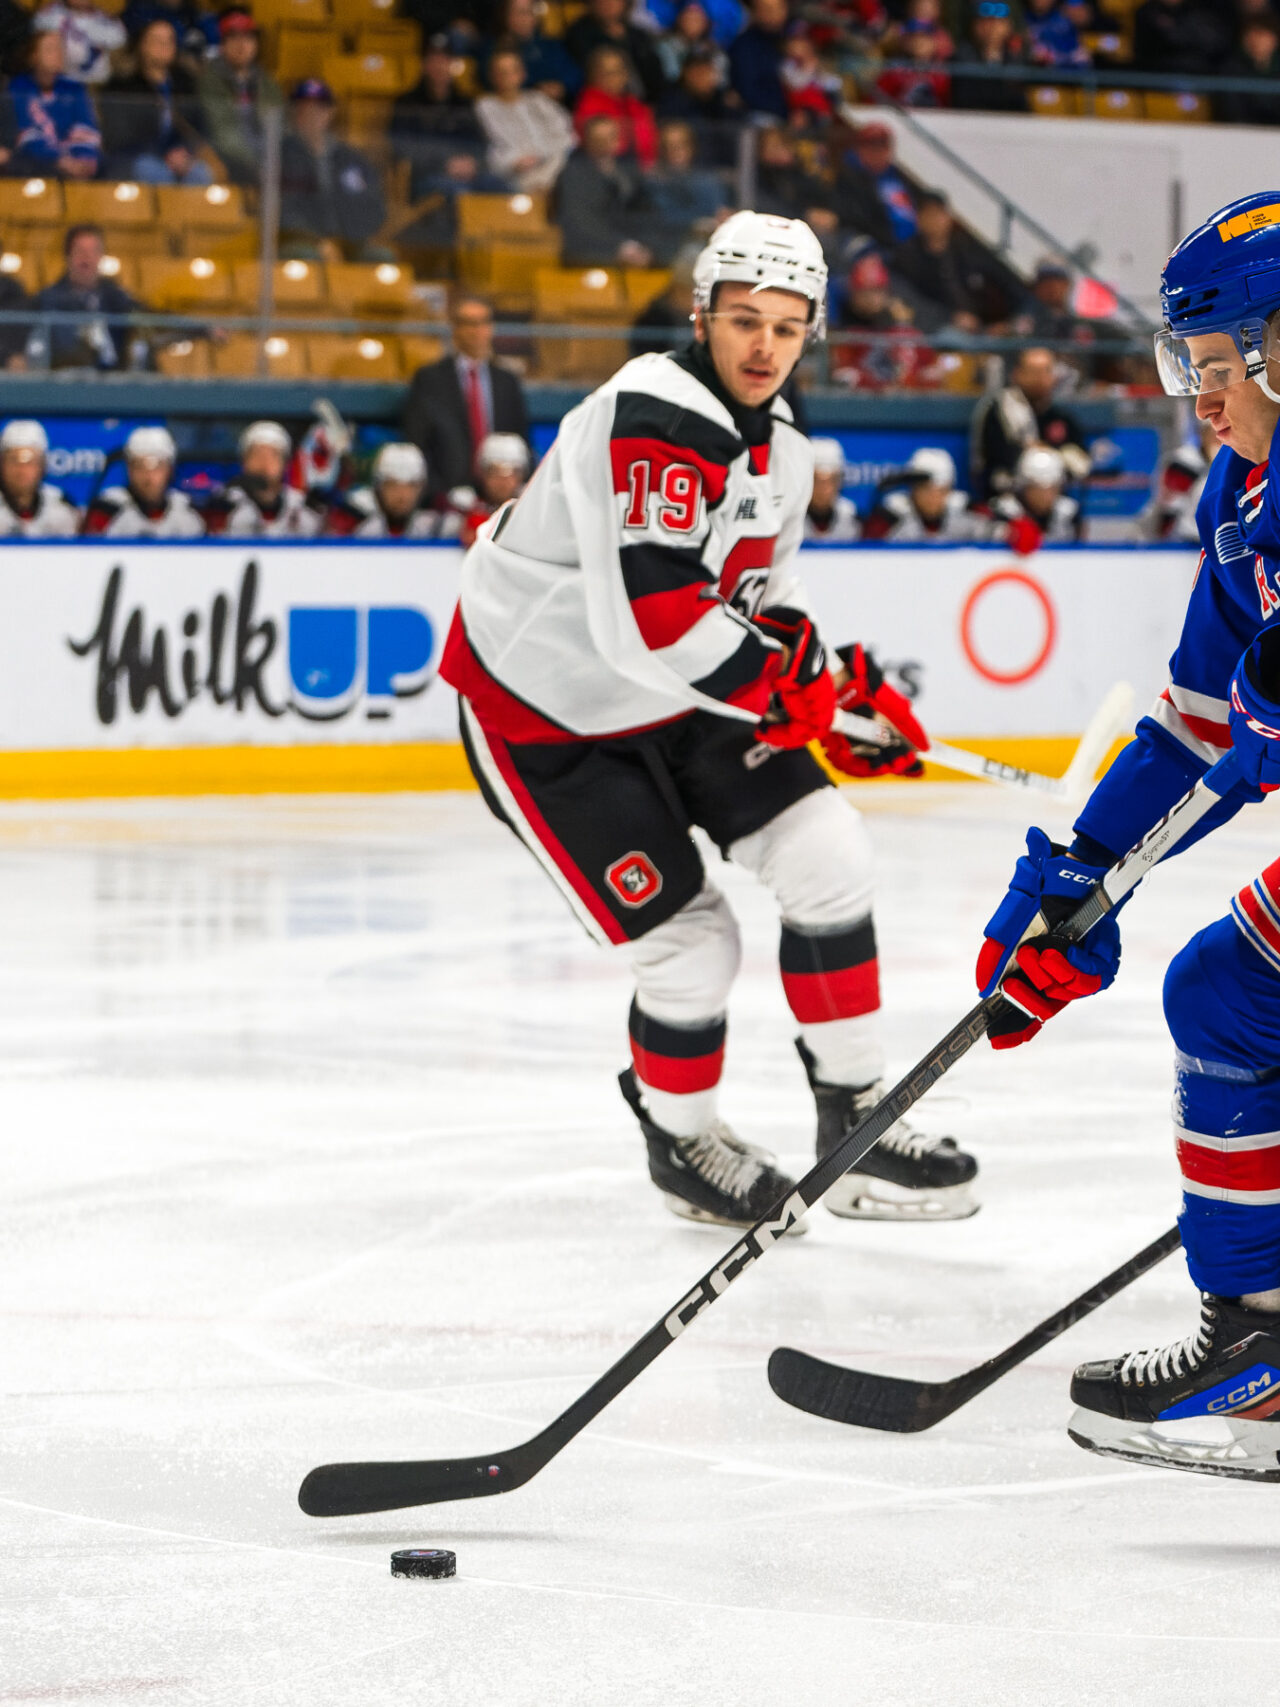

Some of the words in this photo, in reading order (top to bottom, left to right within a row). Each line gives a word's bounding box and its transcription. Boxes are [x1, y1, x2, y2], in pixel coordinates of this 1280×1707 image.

[624, 460, 701, 534] 19
[67, 558, 288, 725] Milk
[664, 1189, 809, 1339] CCM
[1206, 1371, 1272, 1412] CCM
